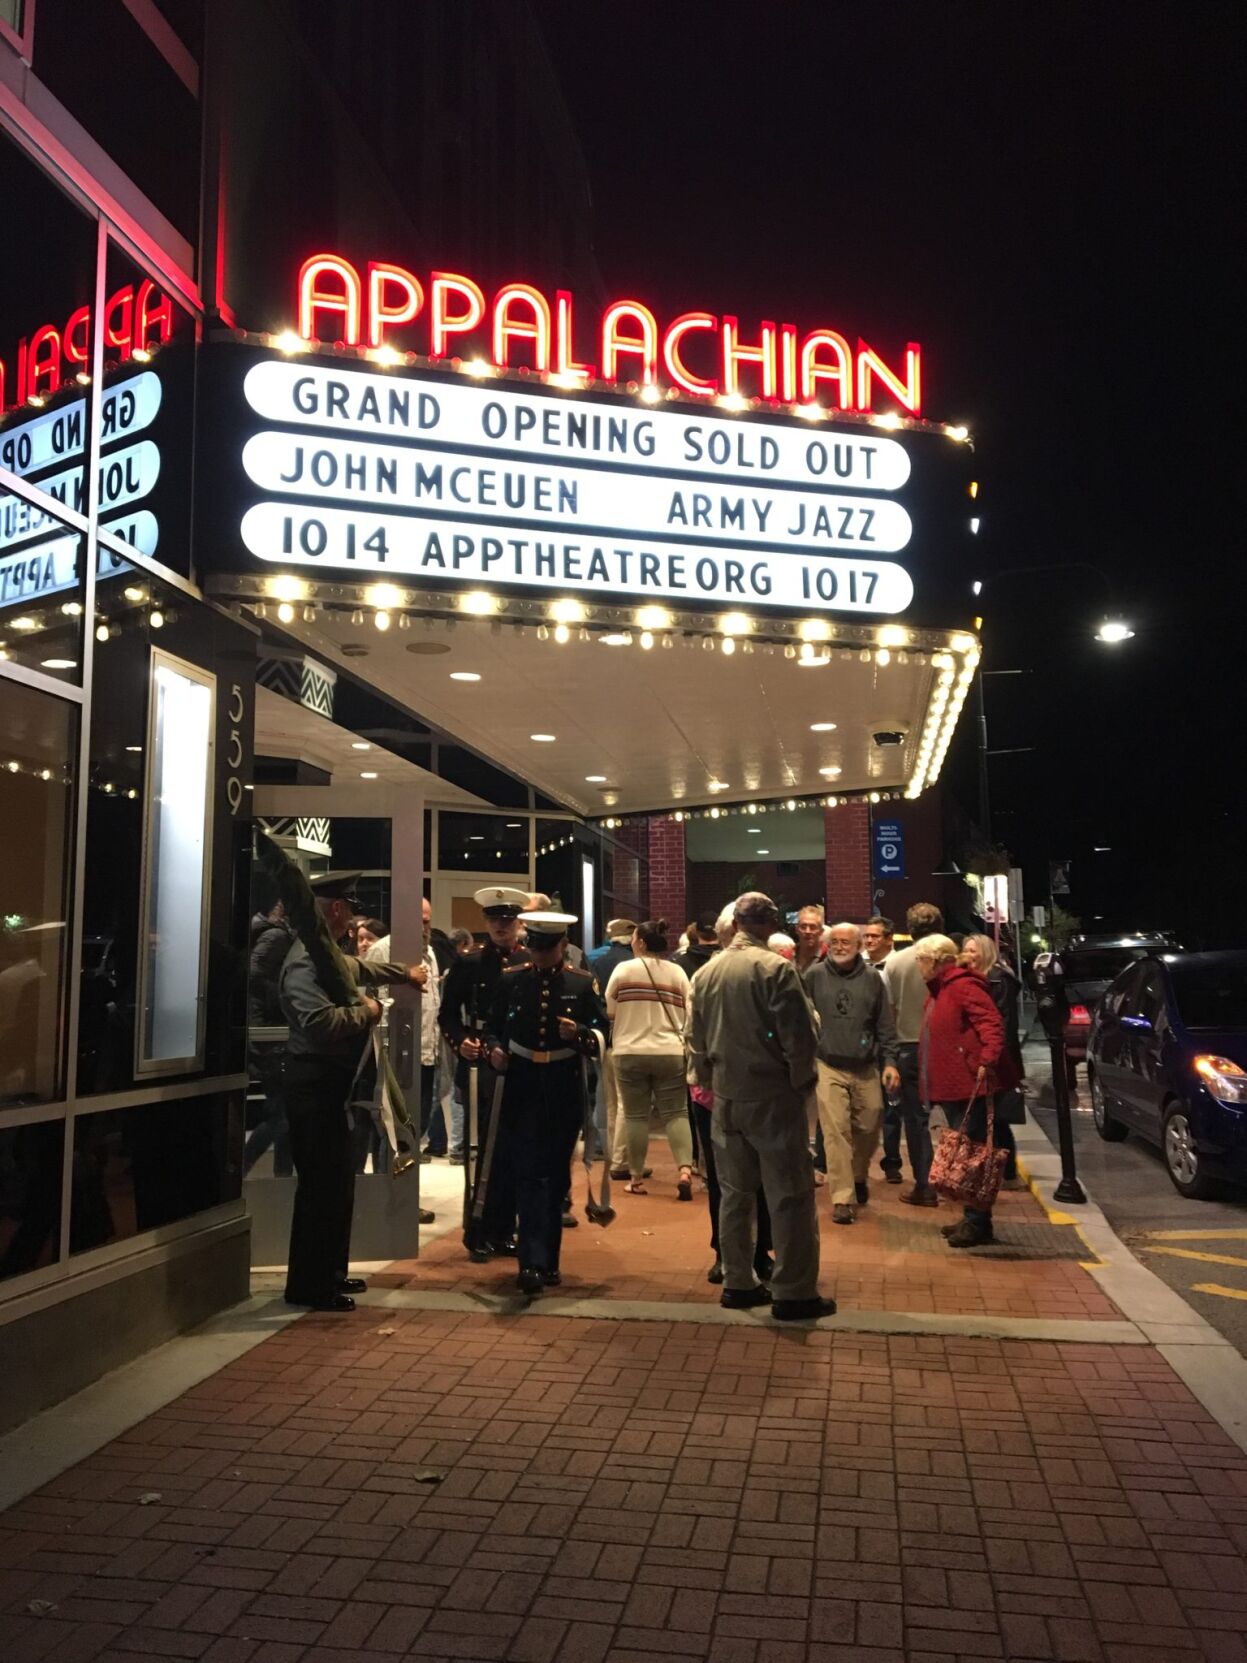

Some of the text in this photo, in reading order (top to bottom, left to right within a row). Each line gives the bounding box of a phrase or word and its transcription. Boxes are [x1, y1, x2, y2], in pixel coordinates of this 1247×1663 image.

[299, 253, 921, 418] APPALACHIAN
[292, 376, 877, 479] GRAND OPENING SOLD OUT
[280, 446, 876, 541] JOHN MCEUEN ARMY JAZZ
[227, 684, 244, 815] 559
